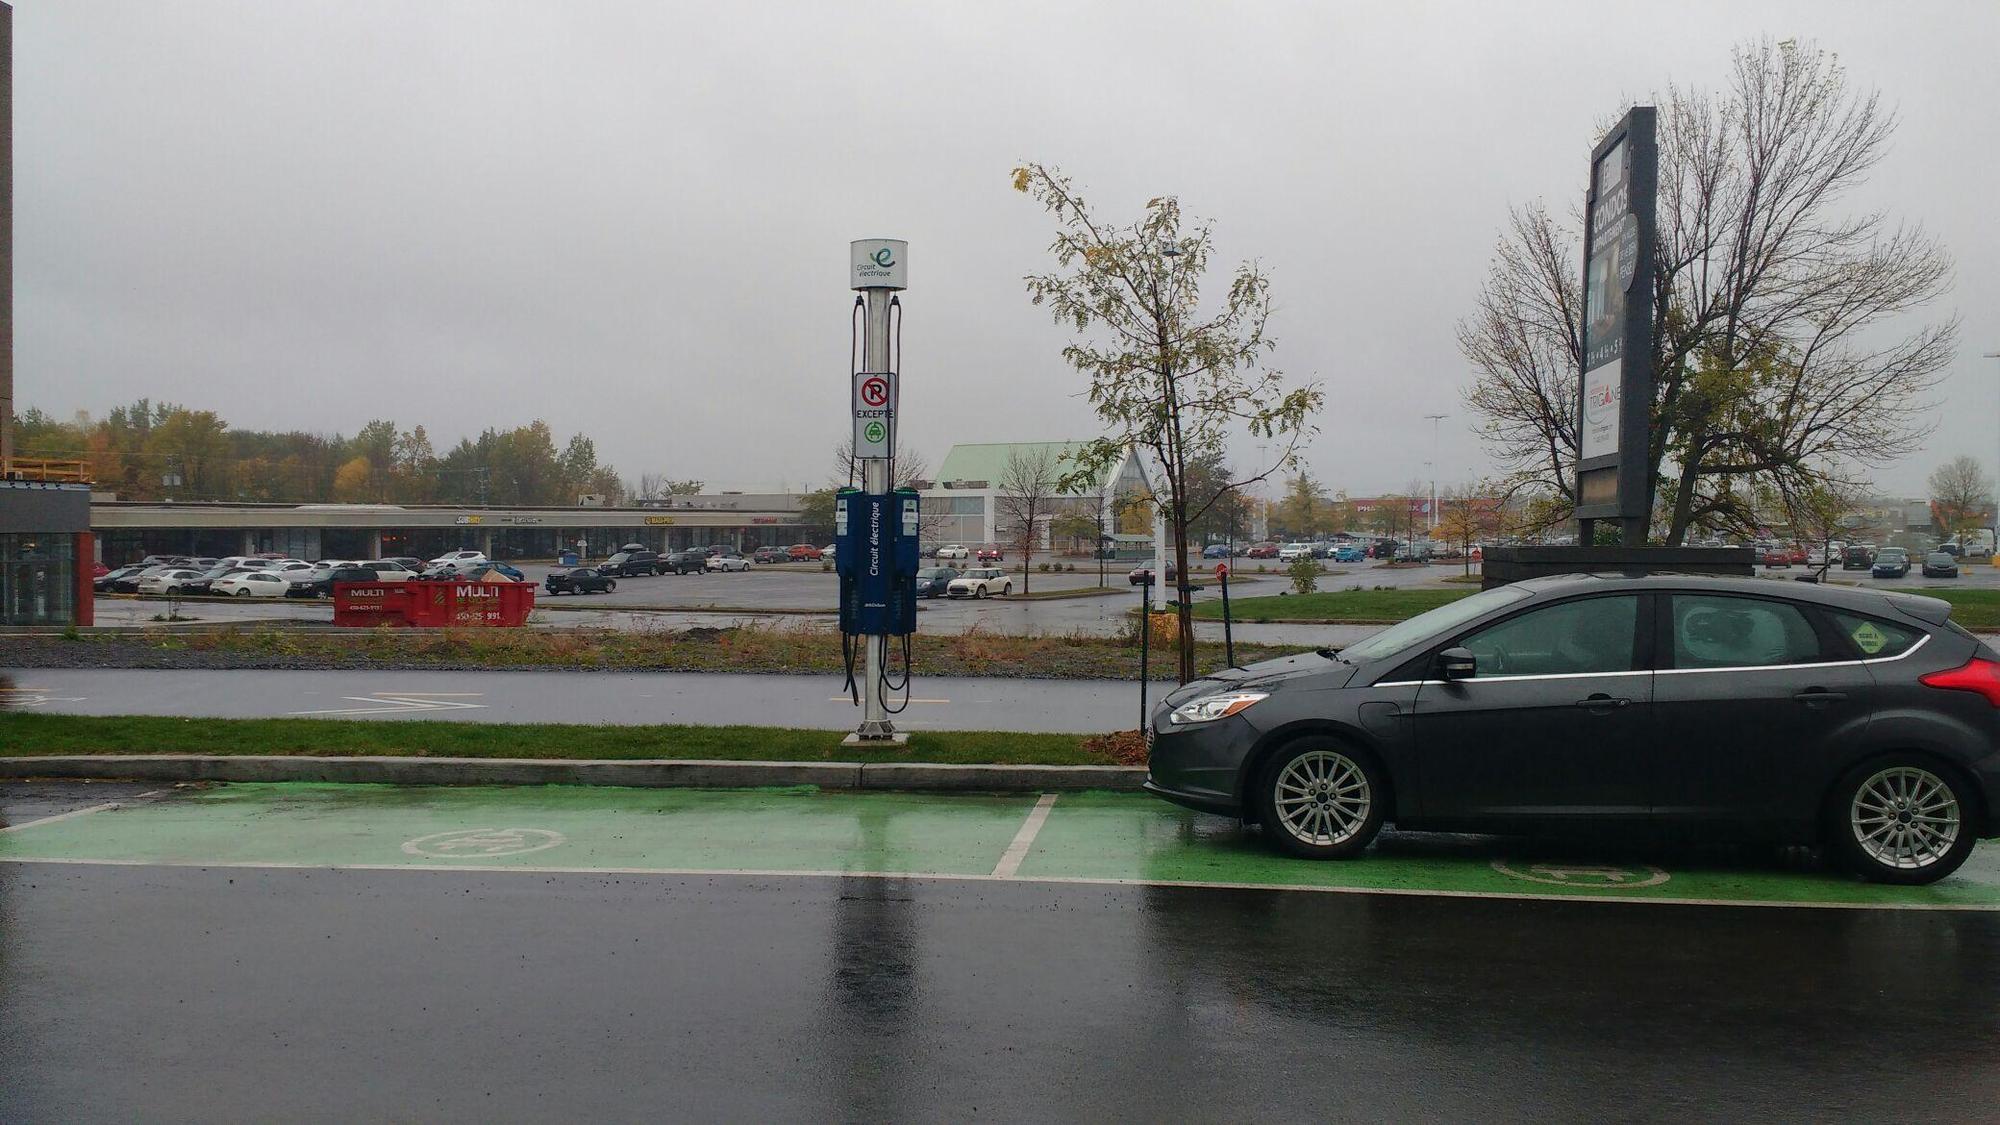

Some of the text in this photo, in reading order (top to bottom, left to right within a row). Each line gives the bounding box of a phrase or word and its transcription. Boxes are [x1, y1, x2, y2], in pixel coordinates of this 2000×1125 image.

[869, 501, 880, 576] Circuit électrique
[351, 589, 384, 597] MULTI
